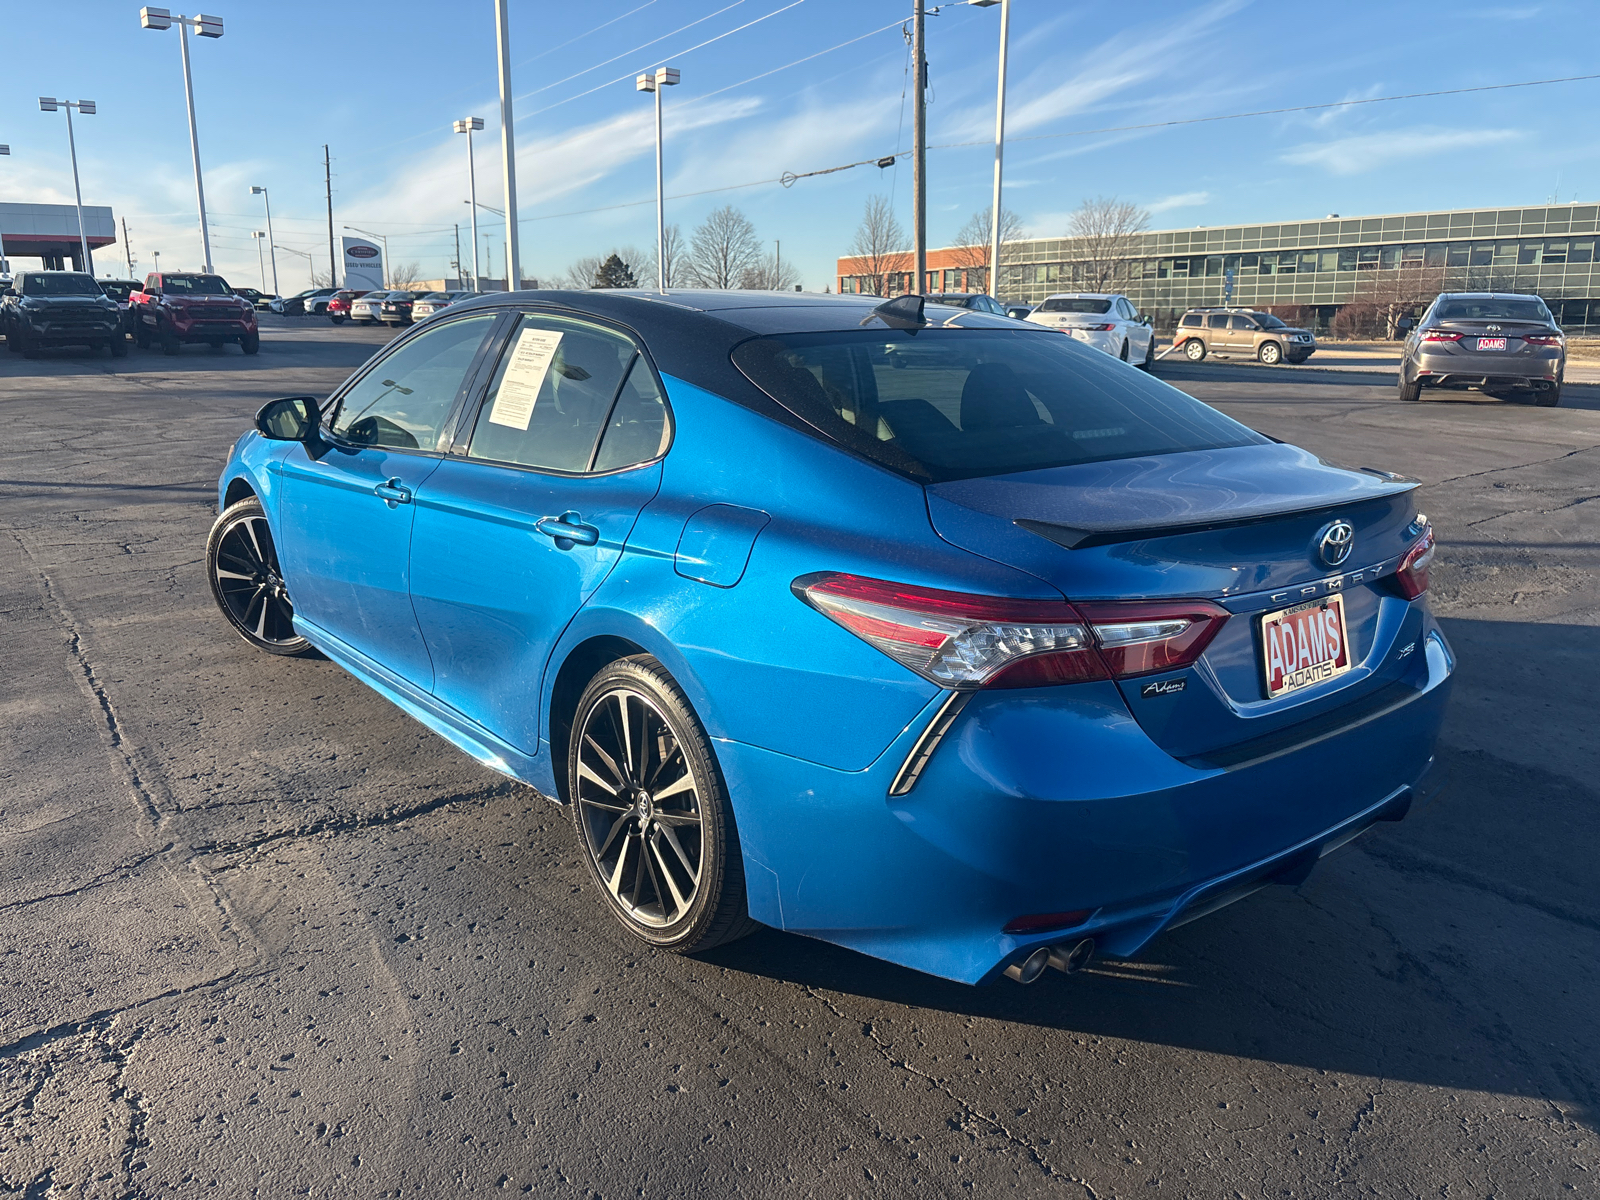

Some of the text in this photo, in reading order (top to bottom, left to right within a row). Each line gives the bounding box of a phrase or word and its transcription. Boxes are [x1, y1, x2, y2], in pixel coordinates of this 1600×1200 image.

[1478, 339, 1505, 349] ADAMS
[1270, 566, 1383, 603] CAMRY
[1282, 603, 1307, 617] KANSAS
[1269, 608, 1341, 682] ADAMS
[1287, 661, 1333, 691] ADAMS
[1143, 681, 1185, 694] Adams
